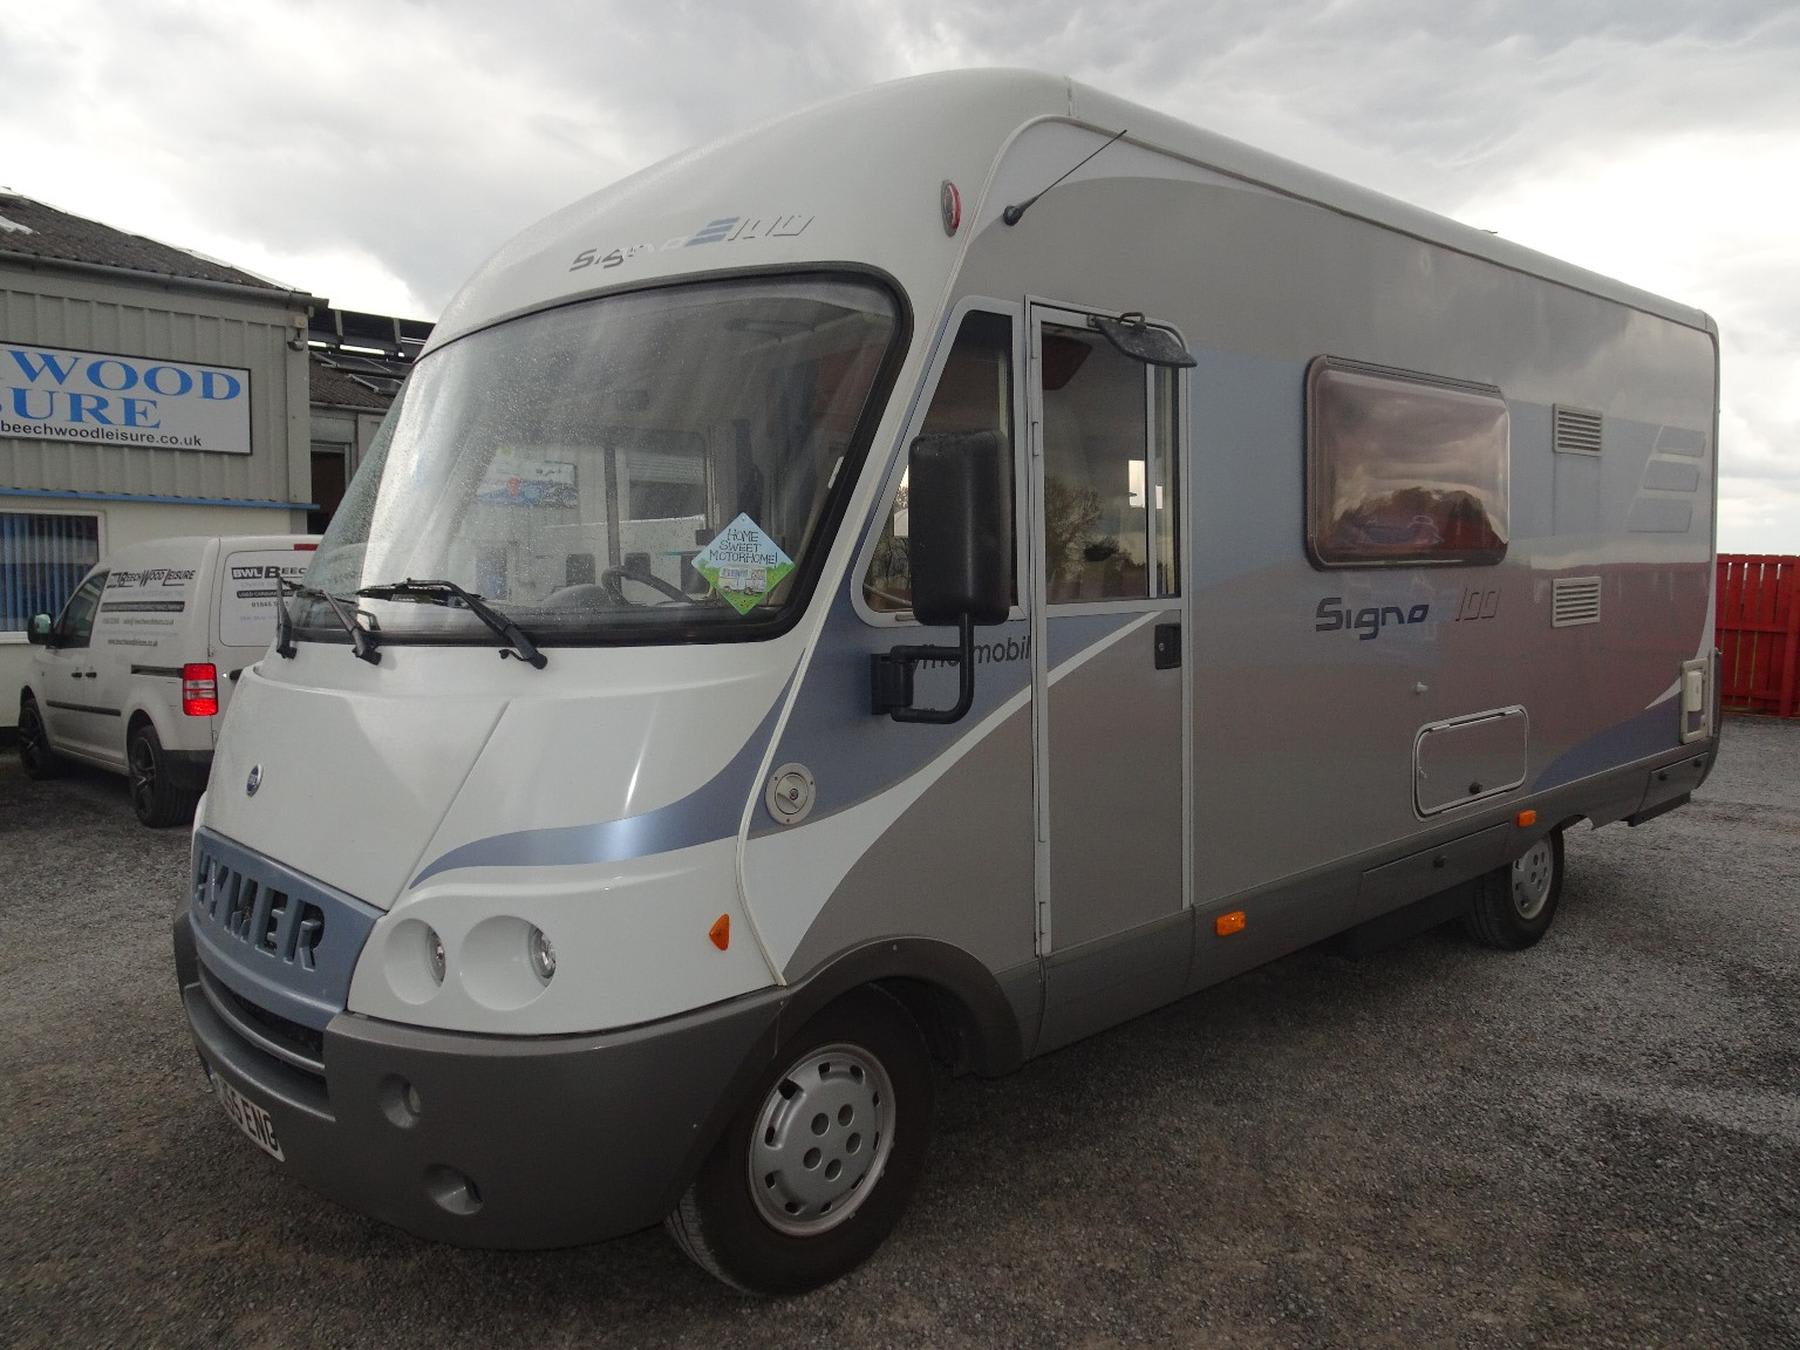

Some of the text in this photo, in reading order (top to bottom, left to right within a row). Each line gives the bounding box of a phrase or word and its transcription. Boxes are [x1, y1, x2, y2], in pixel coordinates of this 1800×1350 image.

[2, 350, 241, 401] WOOD
[0, 386, 161, 429] URE
[719, 540, 762, 553] SWEET
[264, 566, 307, 579] BEEC
